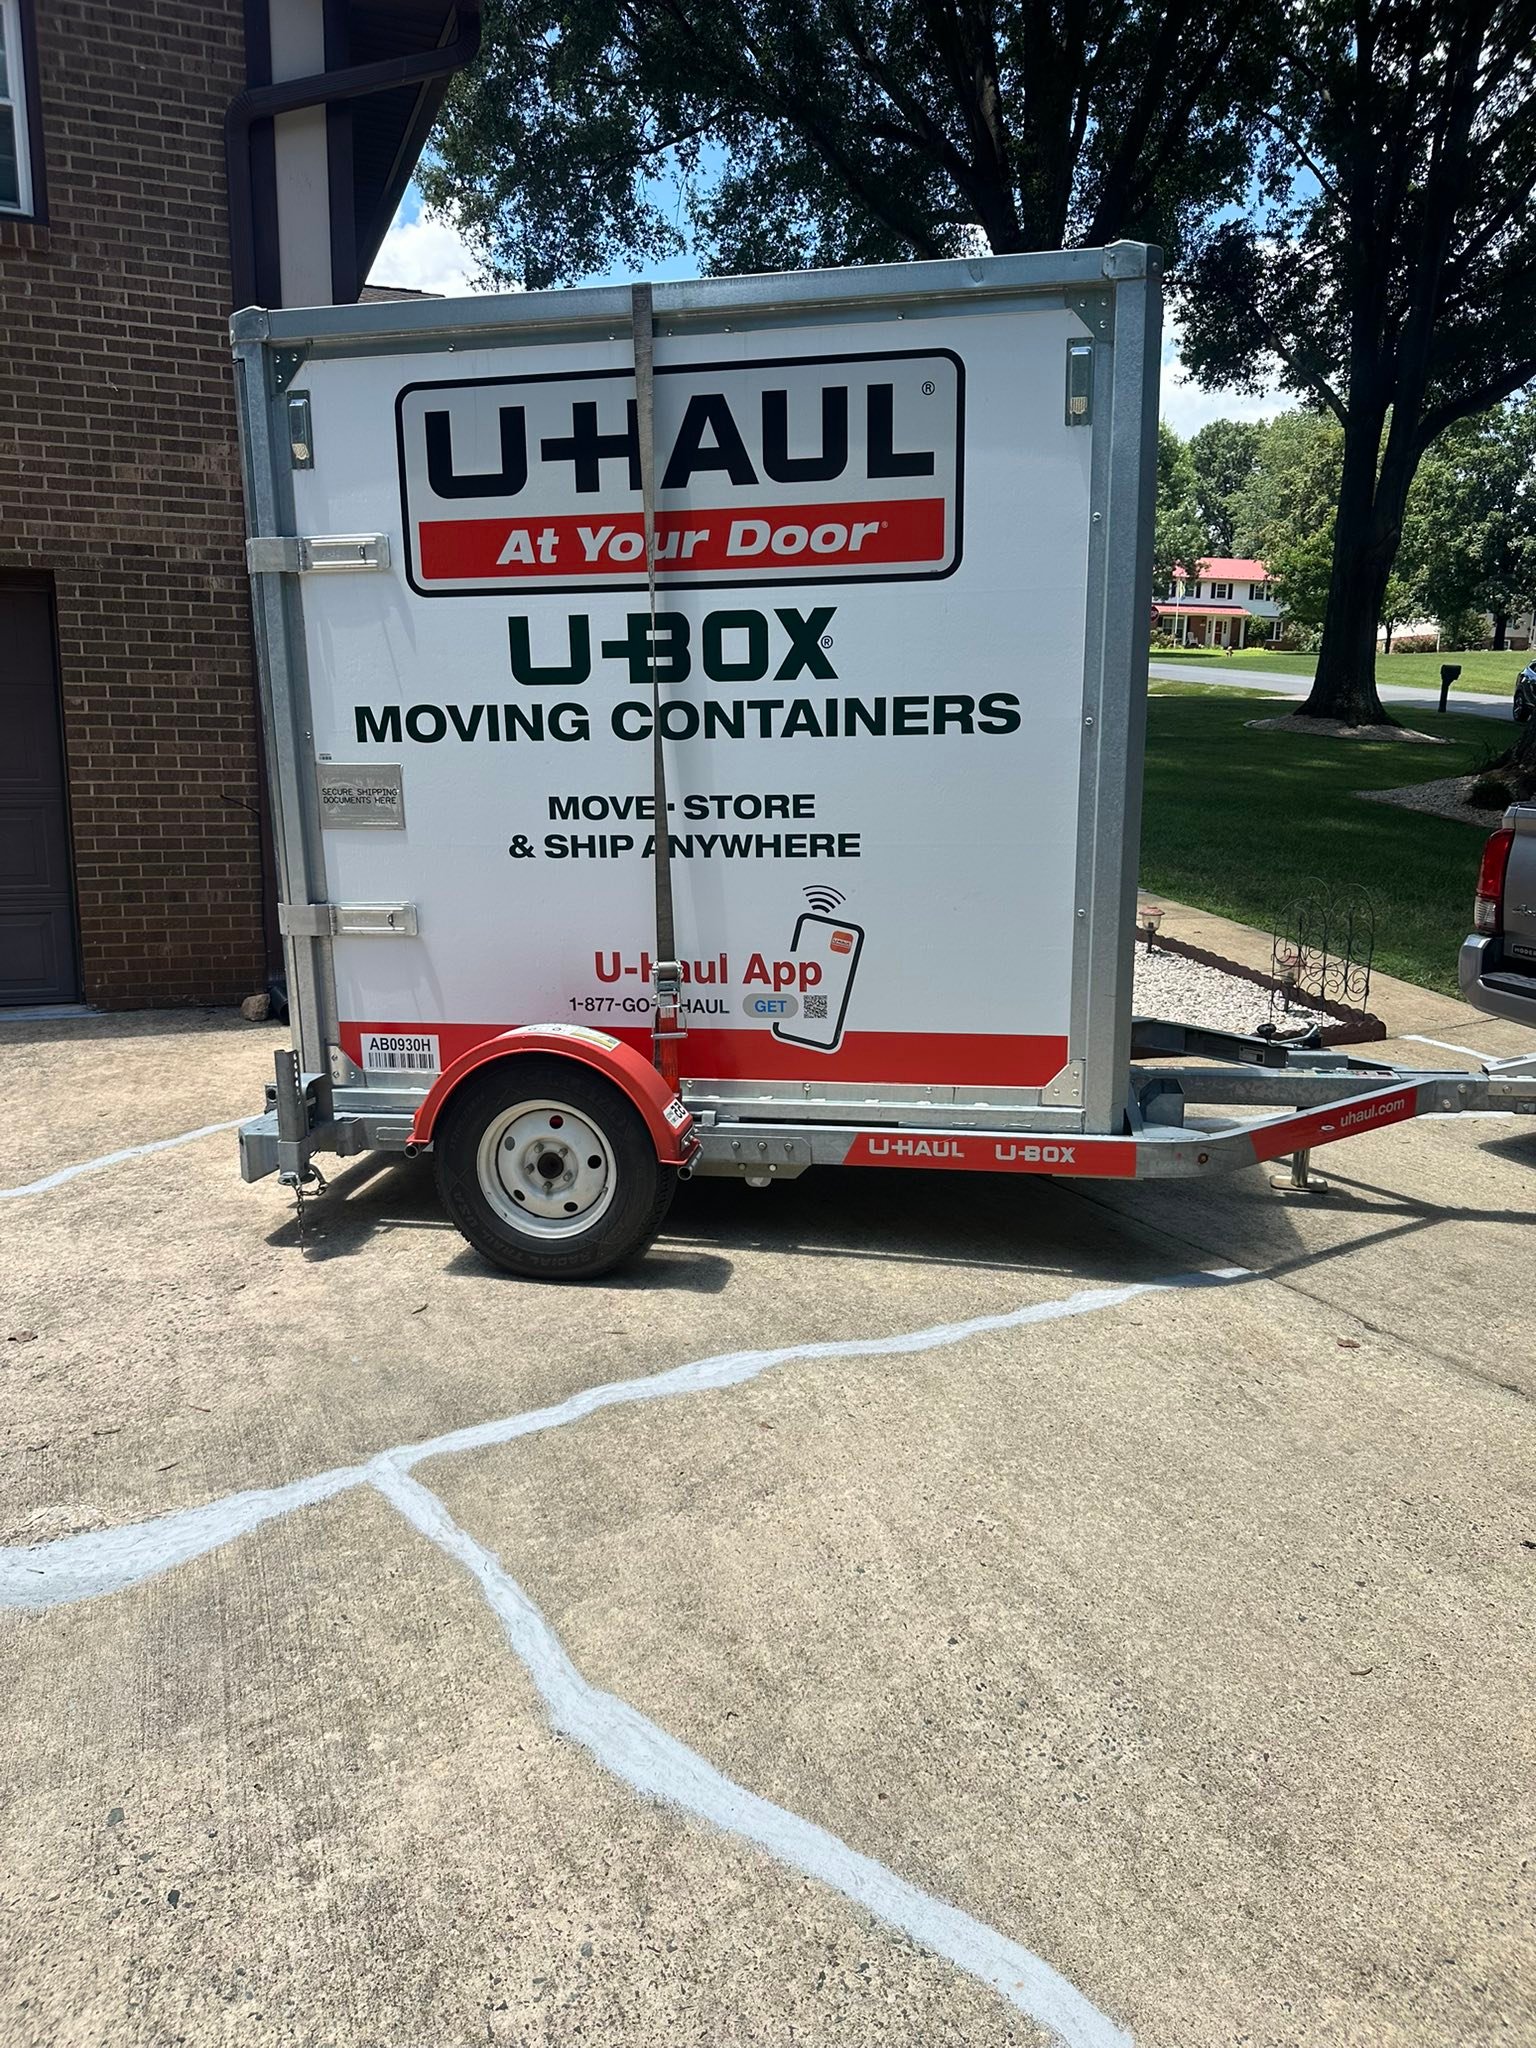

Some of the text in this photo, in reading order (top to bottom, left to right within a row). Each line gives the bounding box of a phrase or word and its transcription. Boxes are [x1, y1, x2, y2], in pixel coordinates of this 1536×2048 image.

[424, 383, 935, 499] U-HAUL
[496, 518, 879, 565] At Your Door
[507, 606, 838, 687] U-BOX
[354, 693, 1022, 744] MOVING CONTAINERS
[322, 788, 397, 796] SECURE SHIPPING
[548, 793, 816, 821] MOVE STORE
[508, 834, 536, 859] &
[543, 833, 634, 859] SHIP
[742, 952, 822, 993] App
[754, 999, 787, 1014] GET
[369, 1037, 431, 1052] AB0930H
[1340, 1098, 1405, 1127] uhaul.com
[868, 1137, 1075, 1163] U-HAUL U-BOX
